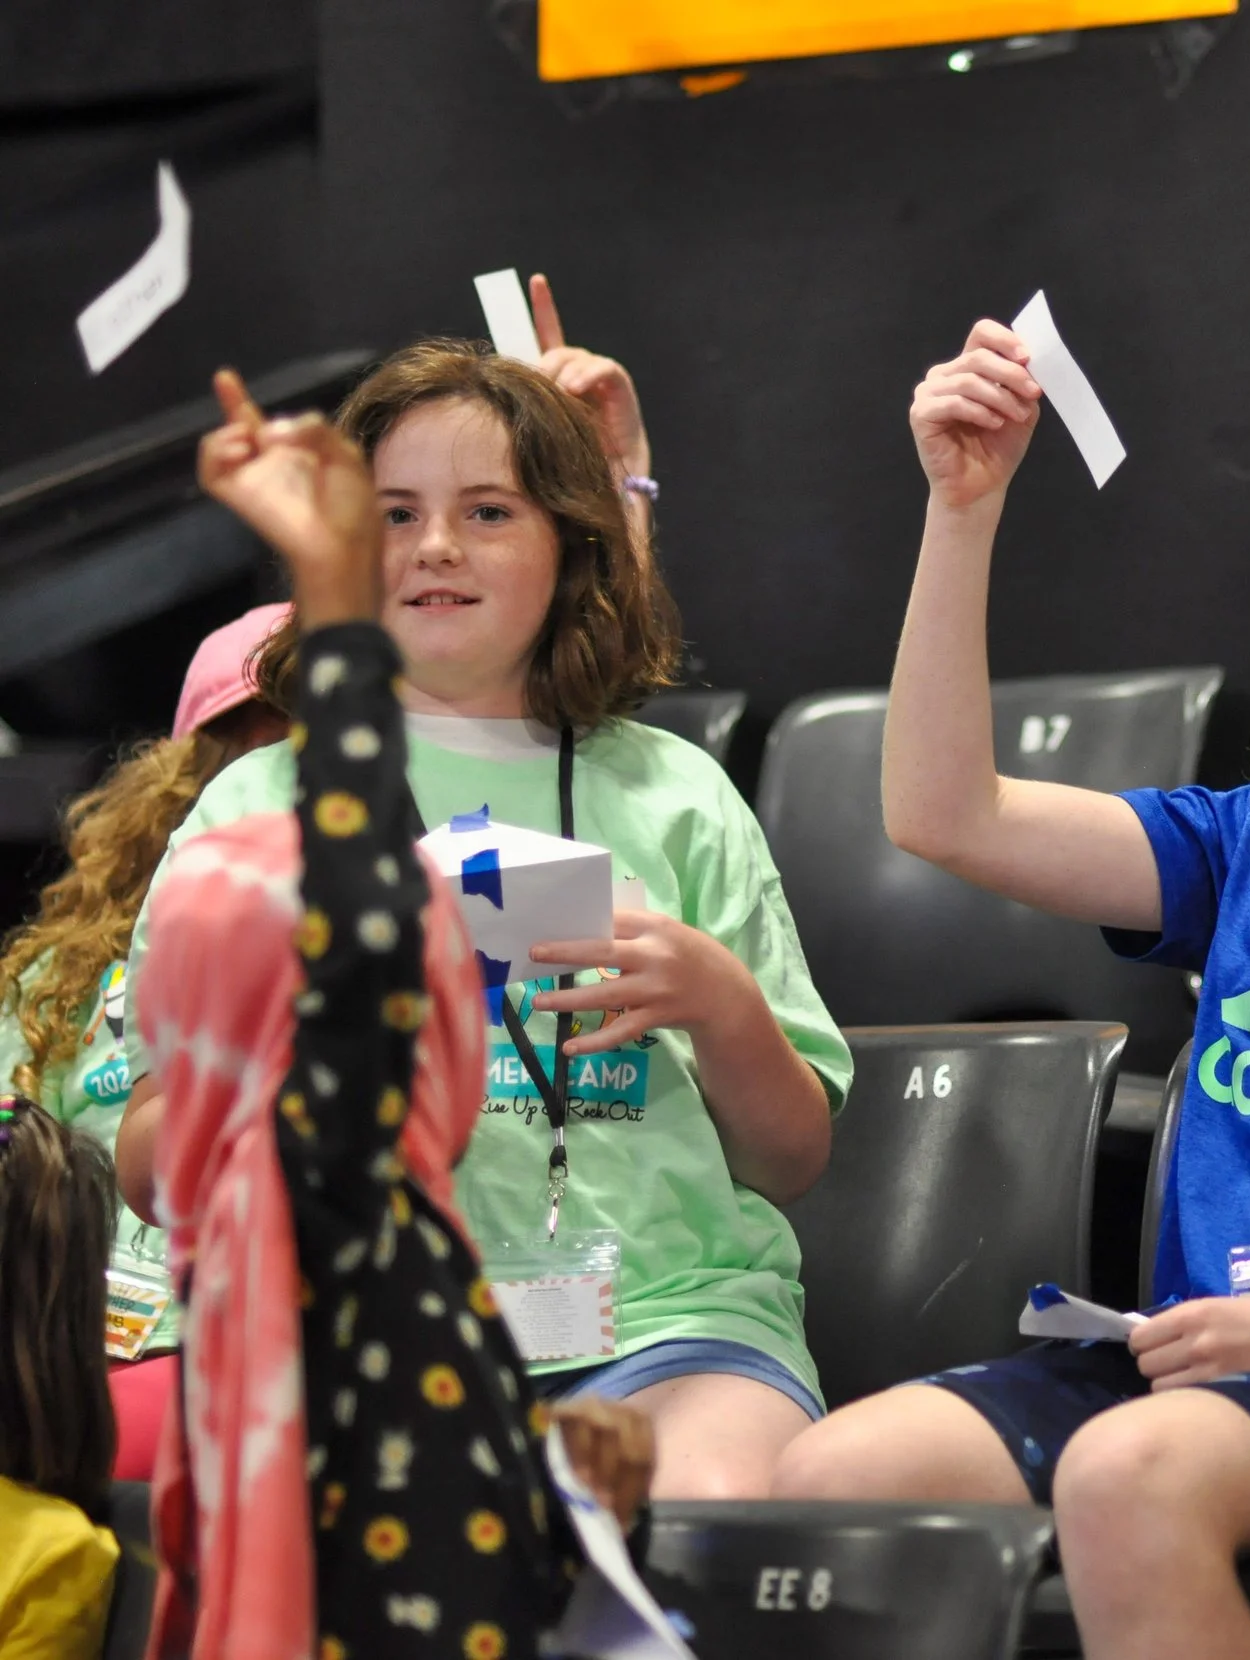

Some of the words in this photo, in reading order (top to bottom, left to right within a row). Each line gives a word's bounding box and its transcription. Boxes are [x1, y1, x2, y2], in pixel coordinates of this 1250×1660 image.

[91, 1065, 133, 1097] 202
[513, 1094, 538, 1125] Up
[566, 1096, 607, 1119] Rock
[608, 1099, 645, 1122] Out
[756, 1567, 801, 1611] EE
[808, 1567, 833, 1612] 8
